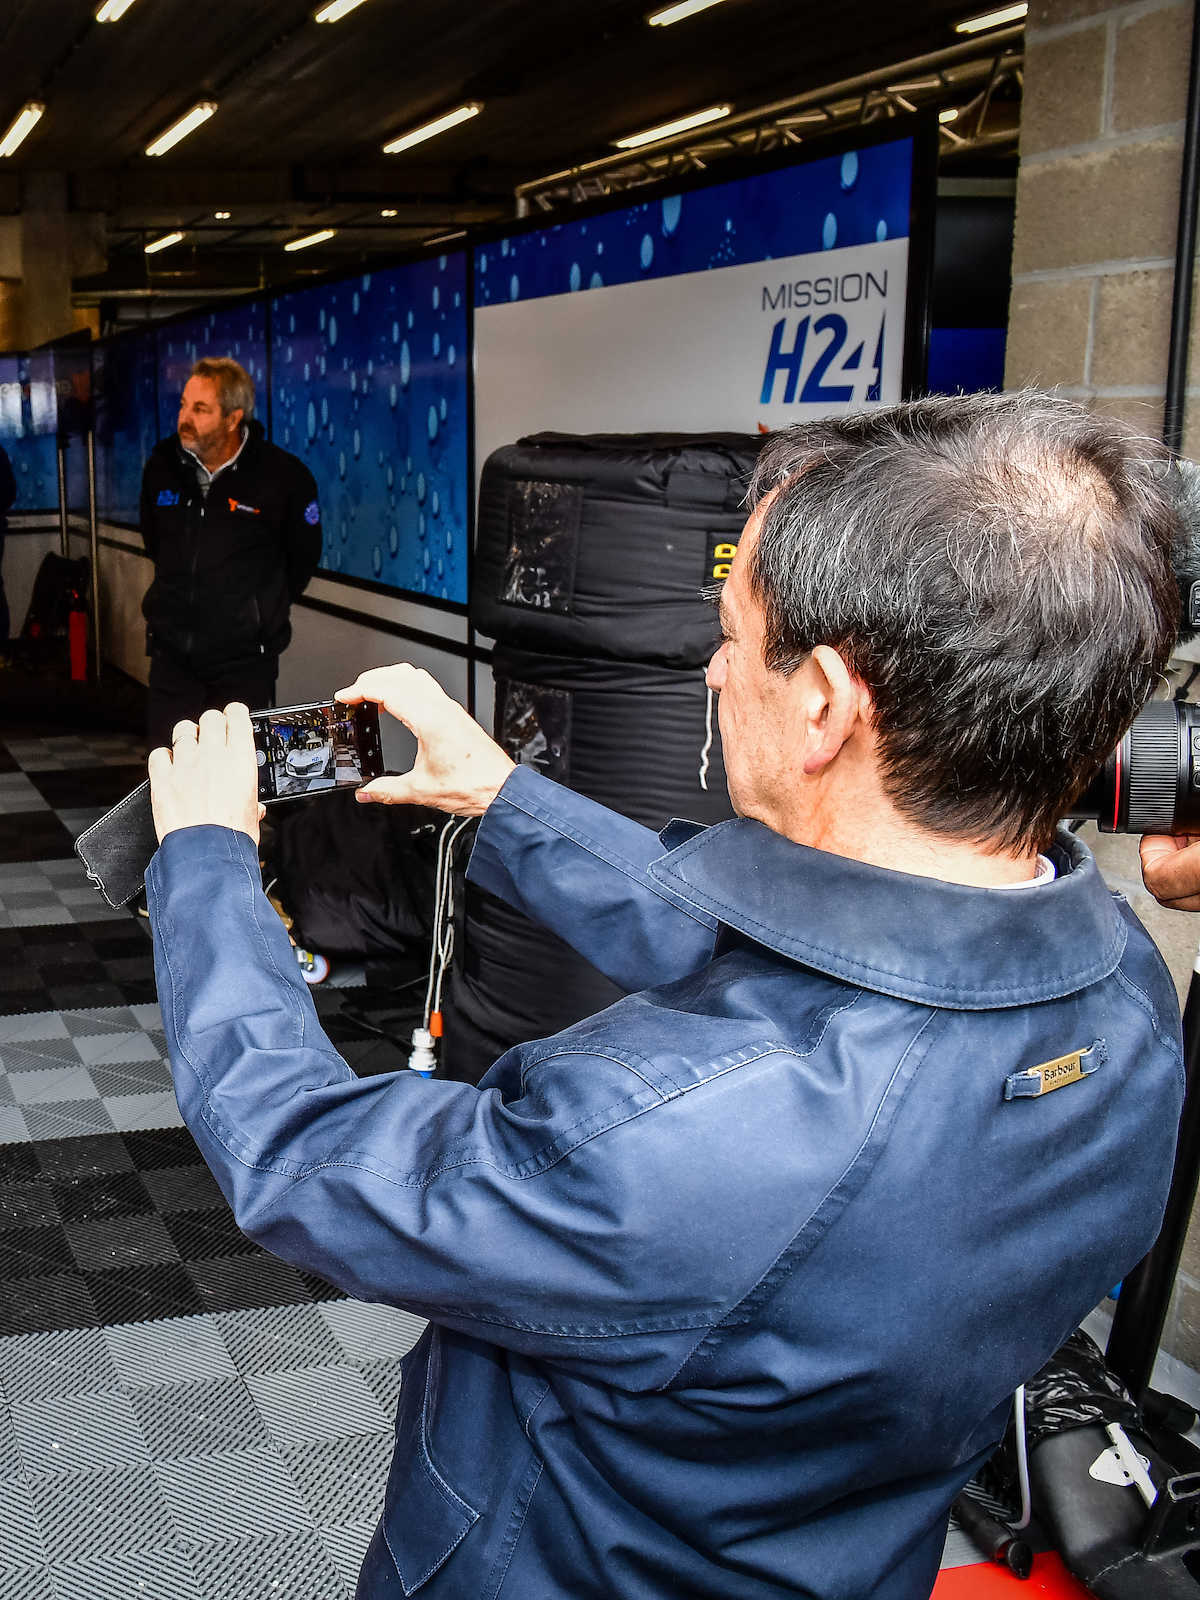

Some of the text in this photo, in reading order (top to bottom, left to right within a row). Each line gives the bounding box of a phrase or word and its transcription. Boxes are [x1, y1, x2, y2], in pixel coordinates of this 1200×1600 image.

[762, 269, 888, 312] MISSION
[759, 309, 886, 405] H24
[1044, 1062, 1077, 1081] Barbour
